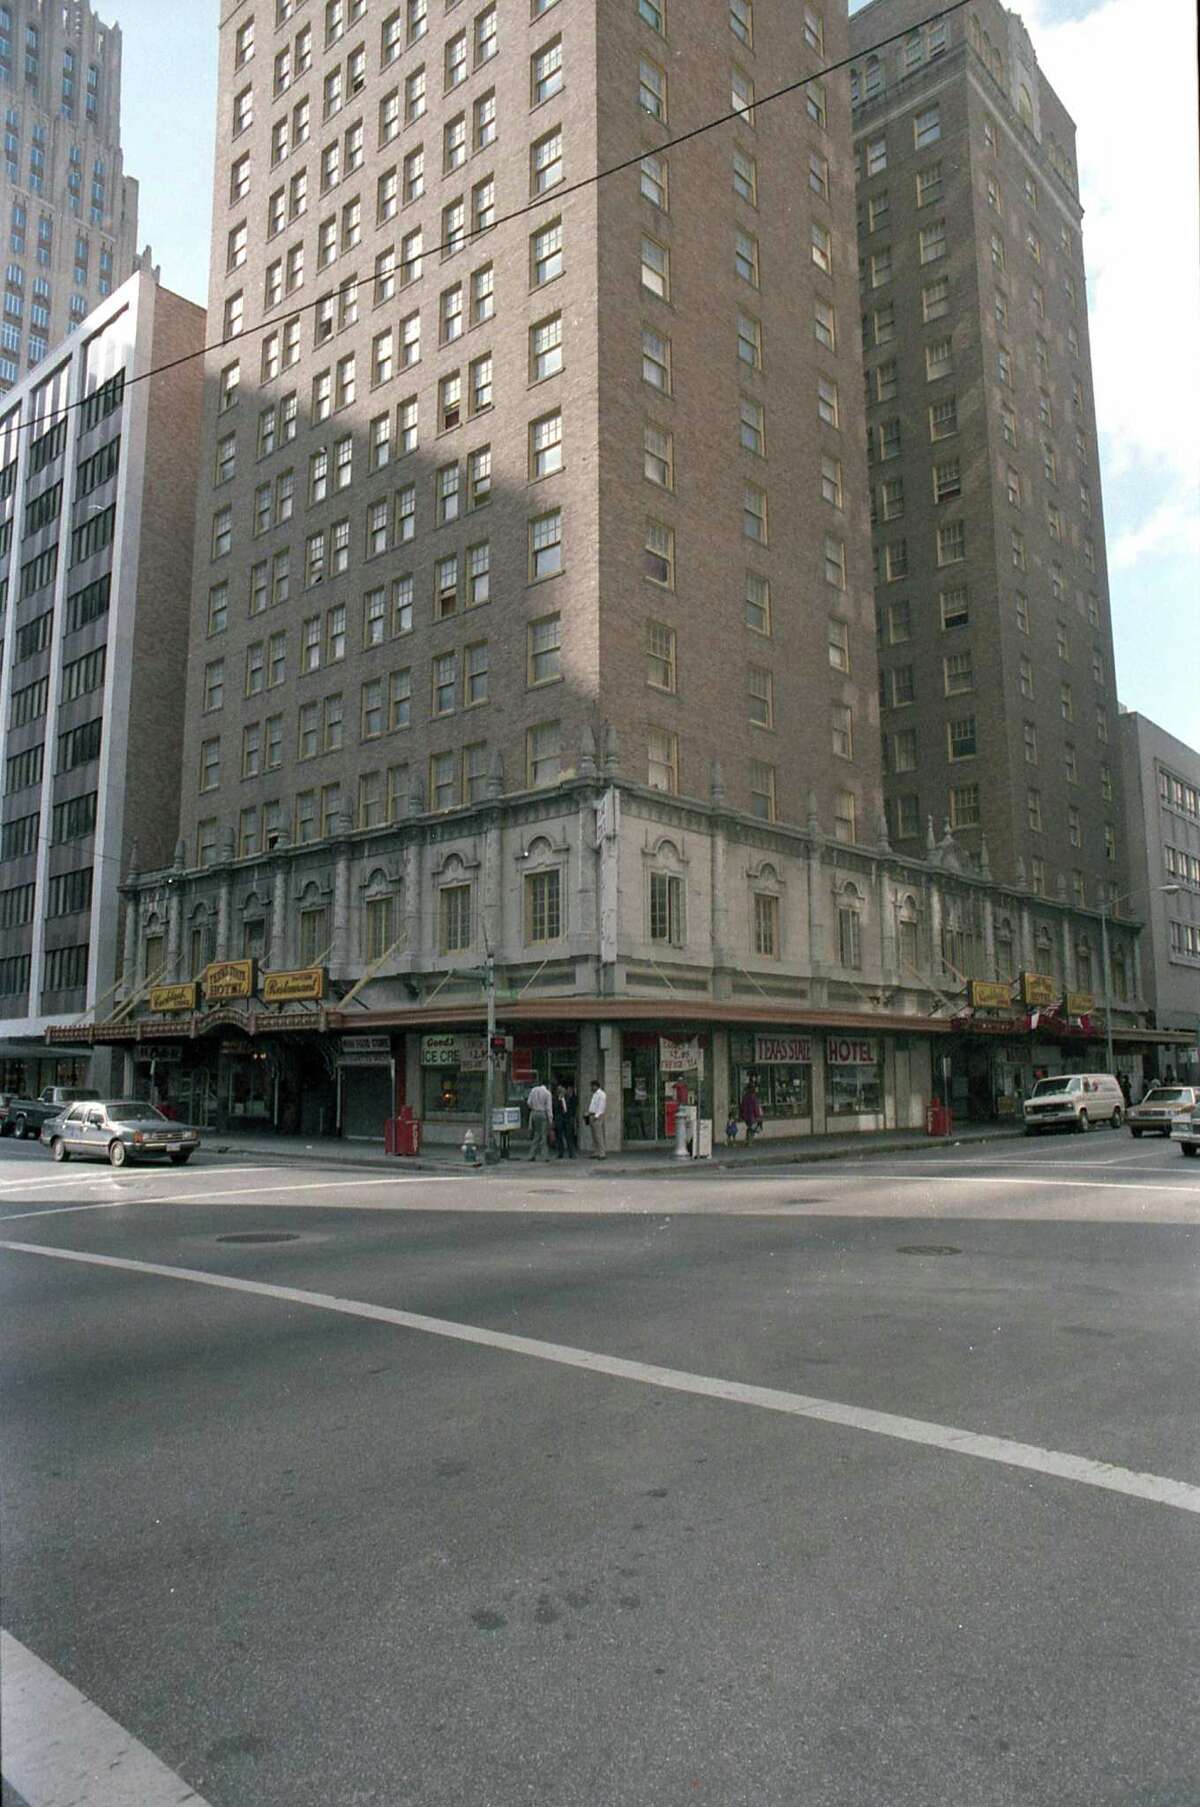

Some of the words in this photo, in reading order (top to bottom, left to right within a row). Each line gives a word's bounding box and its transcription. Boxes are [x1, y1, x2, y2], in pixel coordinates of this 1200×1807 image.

[209, 984, 246, 998] HOTEL
[268, 976, 317, 993] Restaurant
[757, 1038, 787, 1061] TEXAS
[788, 1038, 812, 1061] STATE
[828, 1039, 874, 1062] HOTEL
